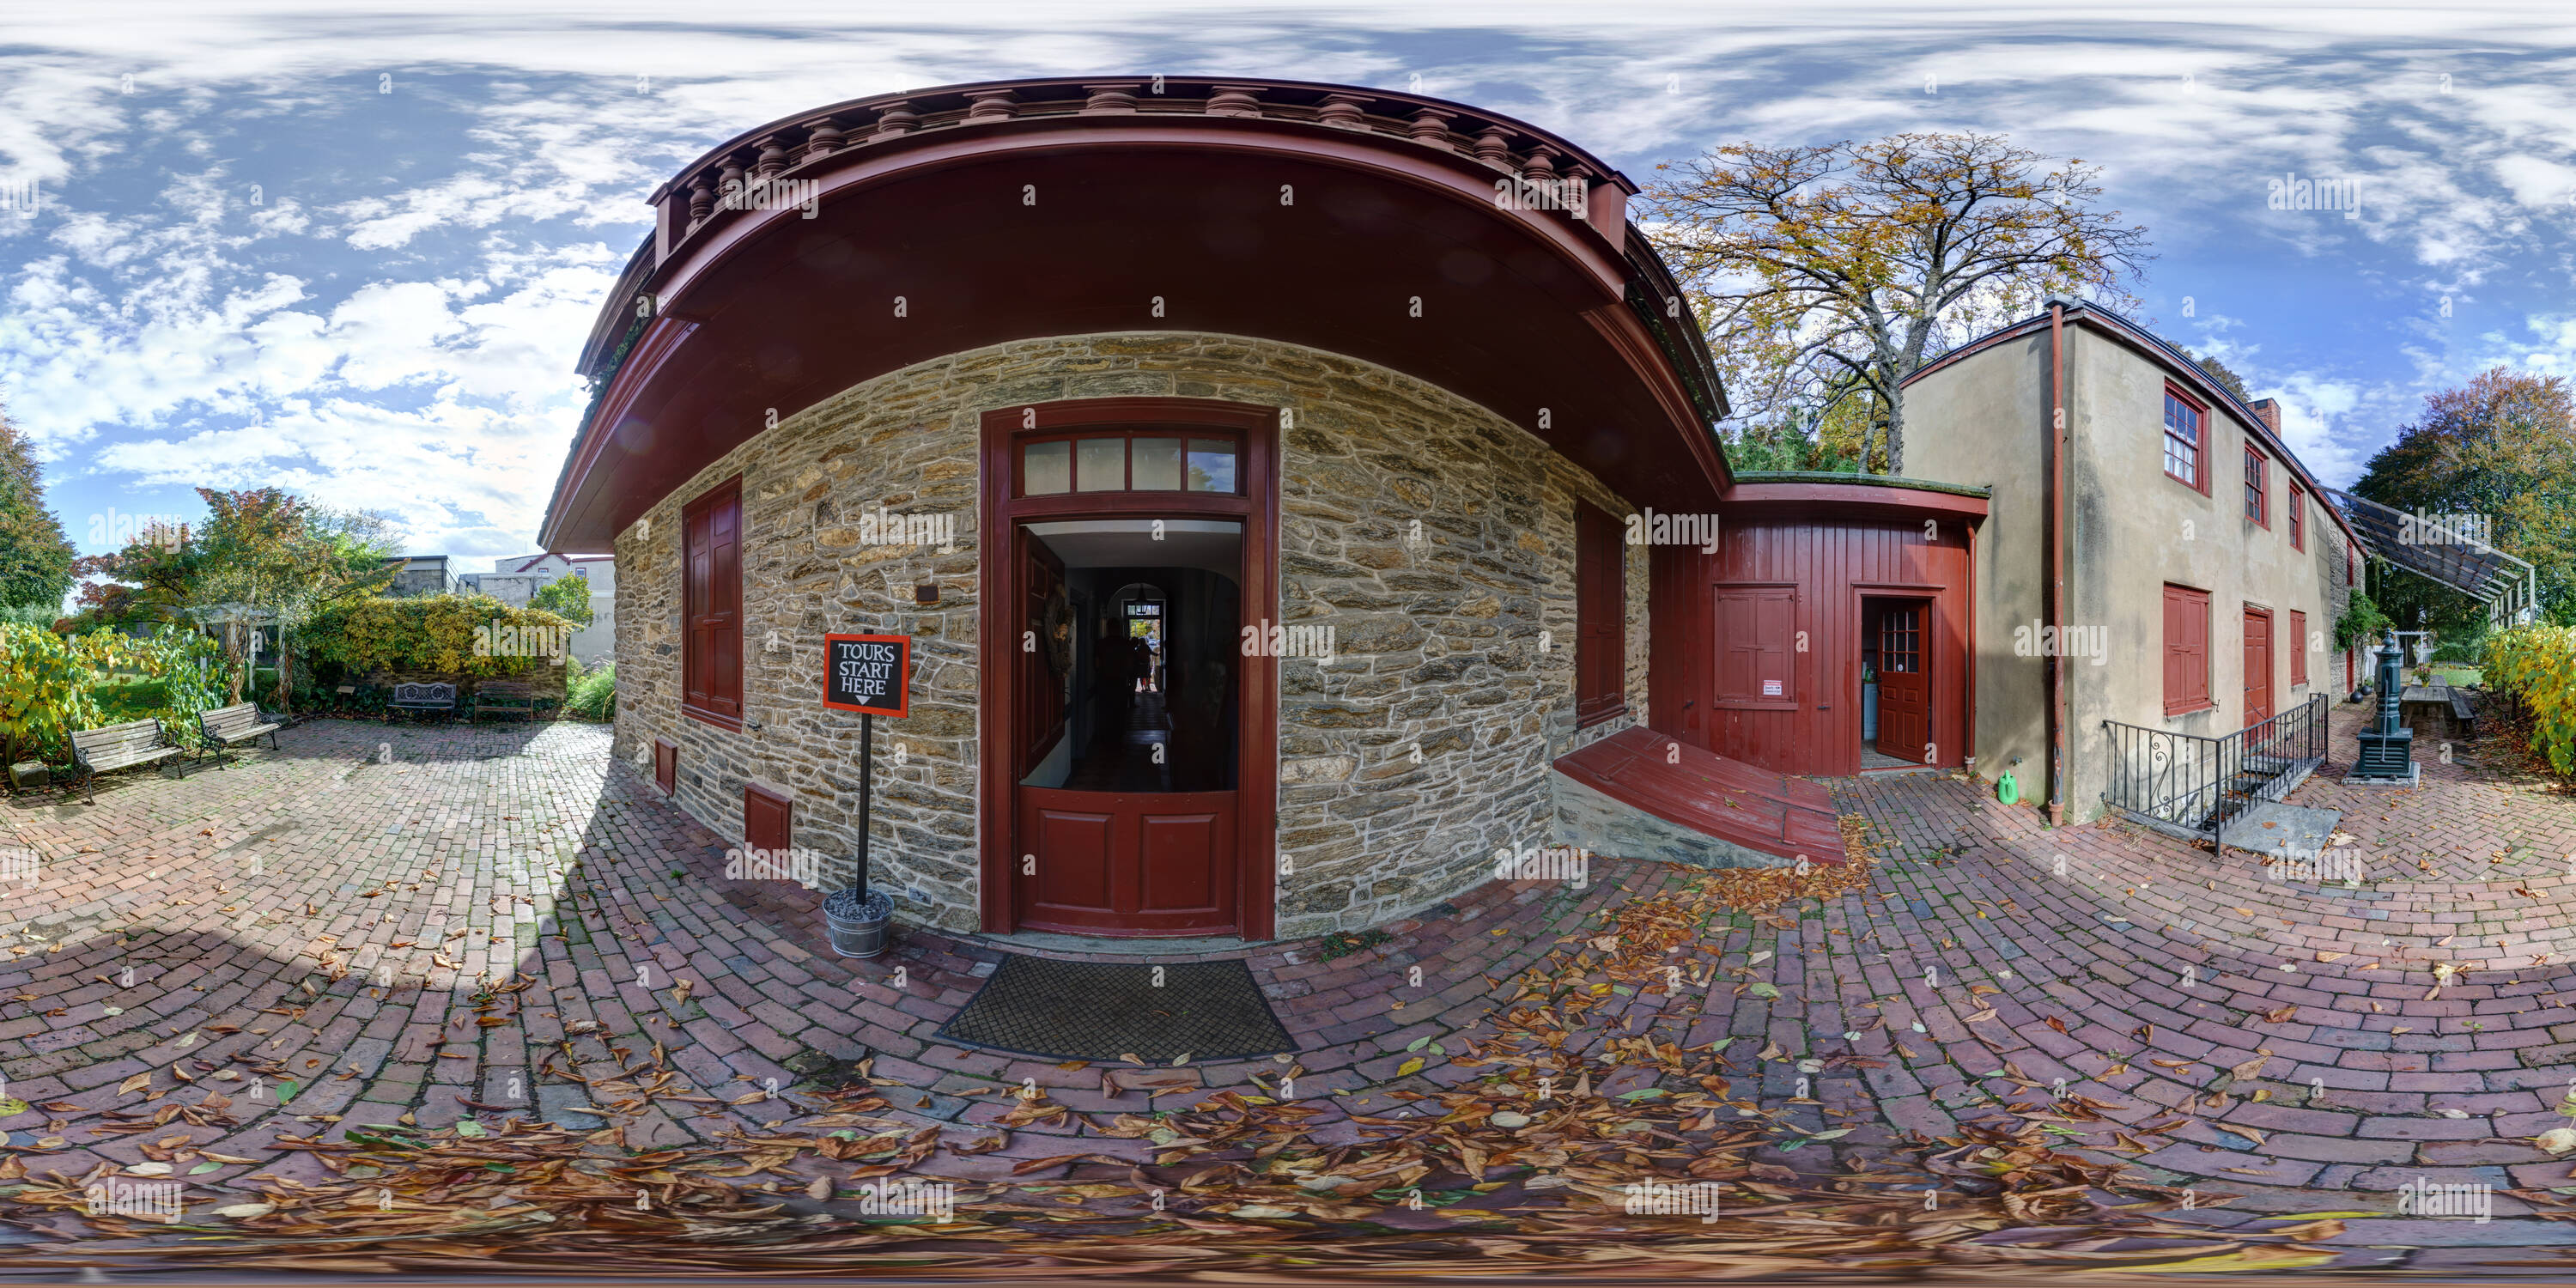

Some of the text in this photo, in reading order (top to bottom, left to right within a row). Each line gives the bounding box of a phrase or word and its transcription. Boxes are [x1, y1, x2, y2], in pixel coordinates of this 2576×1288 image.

[838, 643, 895, 662] TOURS
[839, 661, 893, 679] START
[841, 677, 886, 696] HERE
